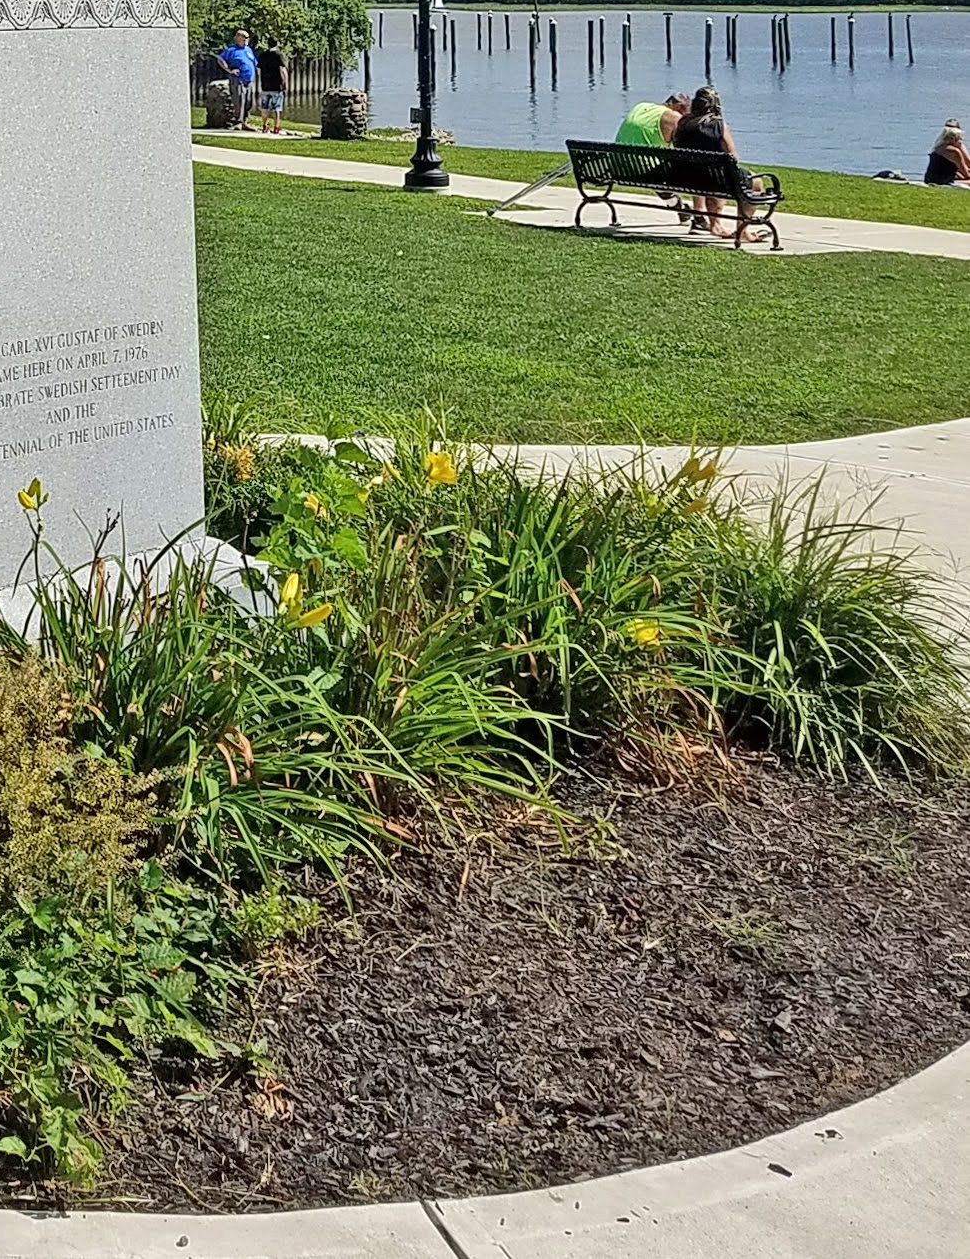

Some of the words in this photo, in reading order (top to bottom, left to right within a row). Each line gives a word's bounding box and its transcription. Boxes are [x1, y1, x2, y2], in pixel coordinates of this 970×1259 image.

[1, 339, 31, 358] CARL
[34, 335, 54, 353] XVI
[56, 328, 100, 349] GUSTAF
[103, 325, 118, 341] OF
[121, 320, 164, 339] SWEDEN
[23, 359, 53, 379] HERE
[56, 356, 73, 373] ON
[76, 350, 108, 370] APRIL
[124, 345, 148, 362] 1976
[37, 378, 88, 402] SWEDISH
[160, 364, 182, 381] DAY
[46, 405, 71, 425] AND
[74, 401, 97, 420] THE
[48, 432, 64, 449] OF
[67, 427, 90, 446] THE
[93, 419, 134, 441] UNITED
[136, 412, 175, 433] STATES
